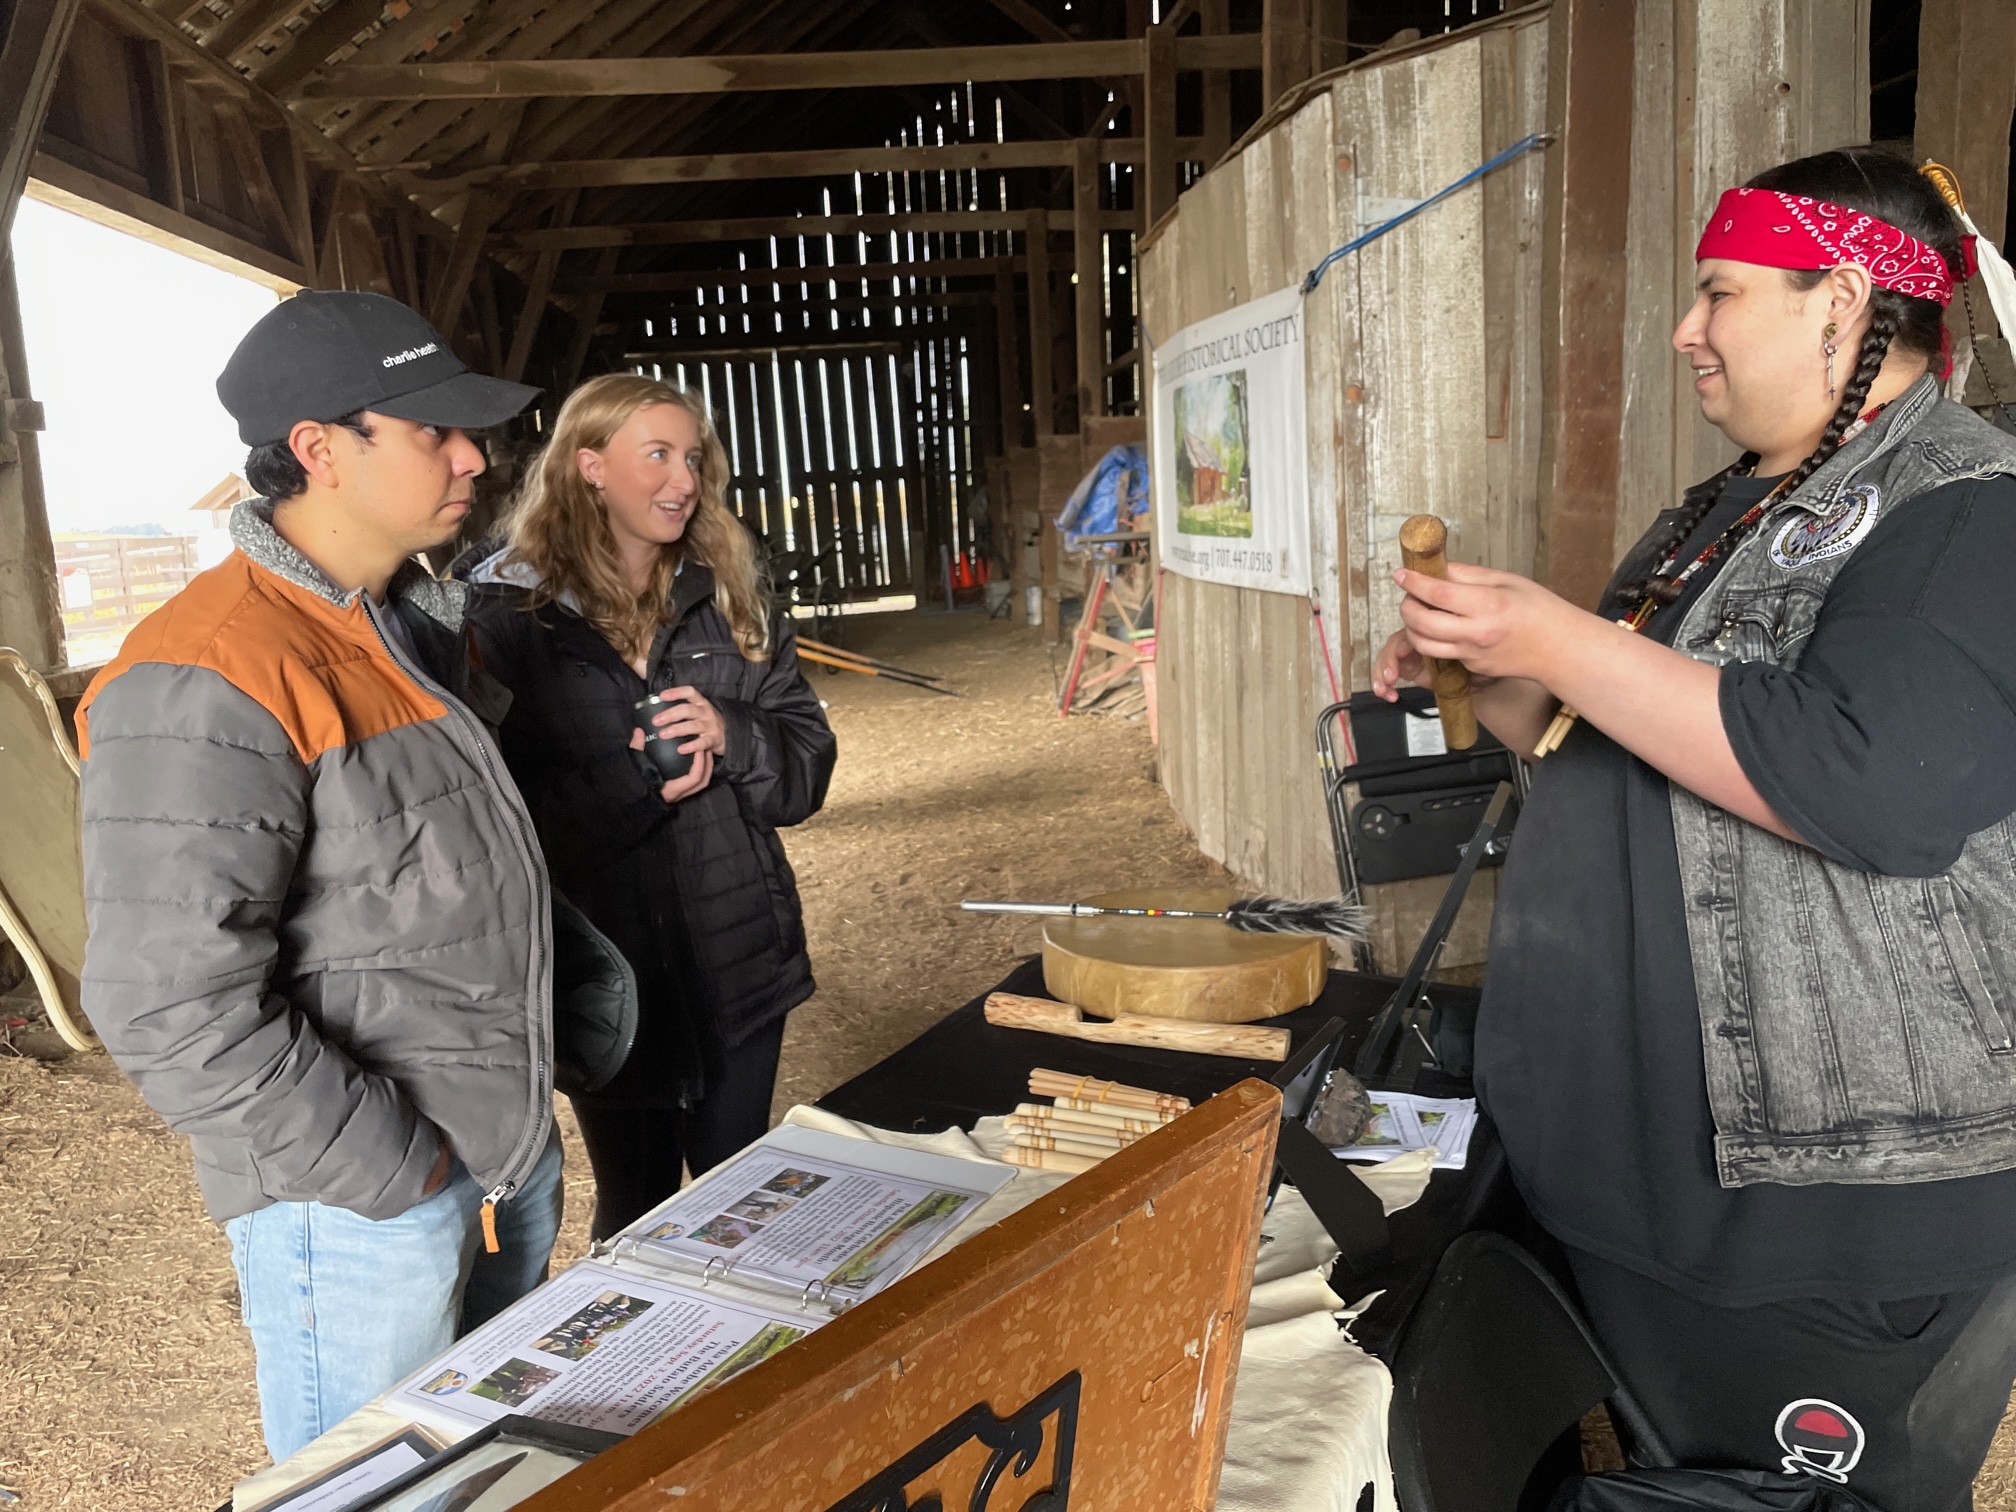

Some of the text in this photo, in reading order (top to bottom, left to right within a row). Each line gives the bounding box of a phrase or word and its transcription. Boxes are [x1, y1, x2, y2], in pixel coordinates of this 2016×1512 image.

[1244, 313, 1299, 356] SOCIETY
[383, 349, 418, 368] charlie
[1215, 547, 1273, 573] 707.447.0518
[1808, 540, 1853, 560] INDIANS
[868, 1197, 904, 1220] Hispanic
[838, 1219, 876, 1244] Heritage
[868, 1216, 895, 1233] Adobe
[830, 1232, 874, 1262] Celebrates
[682, 1320, 727, 1350] Saturday,
[660, 1349, 690, 1367] Sept.
[614, 1339, 722, 1419] The Buffalo Soldiers
[623, 1339, 741, 1428] Peña Adobe Welcomes
[630, 1374, 659, 1393] 2022
